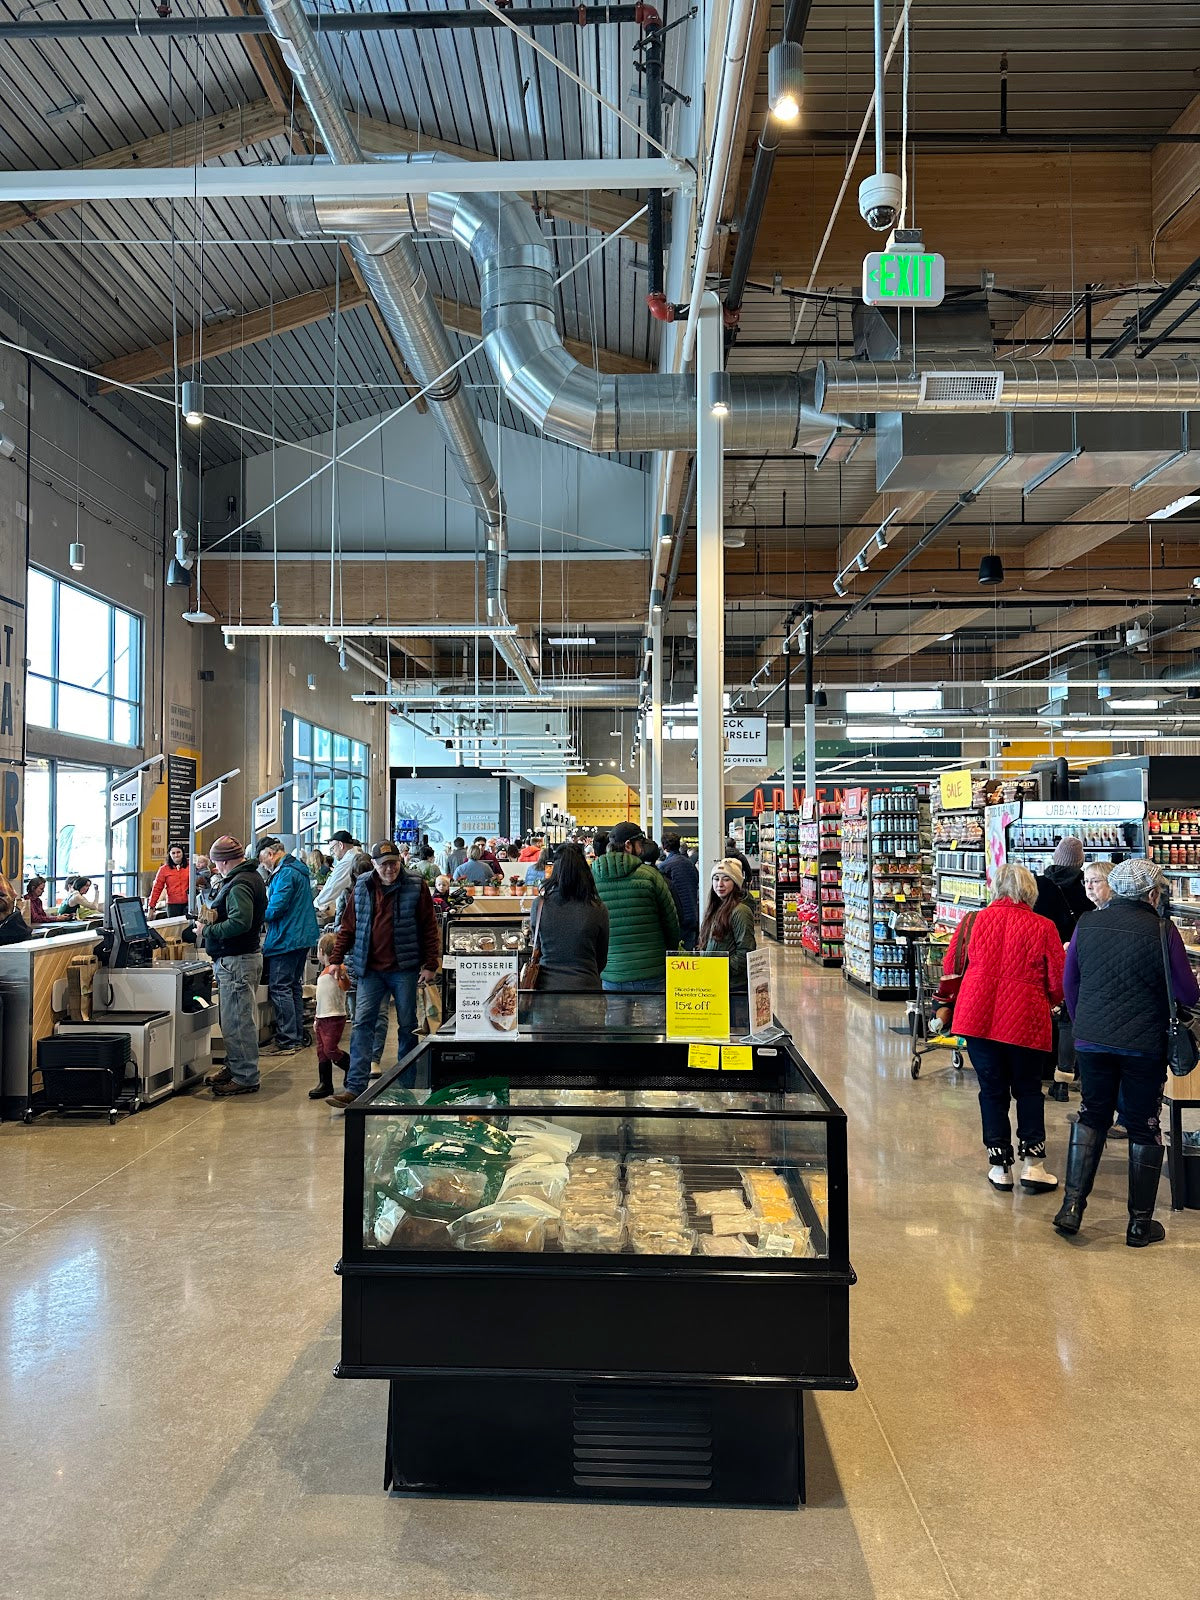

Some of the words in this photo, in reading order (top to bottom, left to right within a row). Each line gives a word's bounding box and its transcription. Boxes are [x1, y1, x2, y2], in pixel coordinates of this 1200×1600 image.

[880, 255, 936, 297] EXIT
[723, 719, 744, 728] ECK
[946, 780, 963, 799] SALE
[113, 793, 137, 802] SELF
[677, 800, 699, 810] YOU
[1046, 804, 1079, 816] URBAN
[1082, 804, 1121, 816] REMEDY
[671, 960, 700, 971] SALE
[675, 1001, 692, 1011] 15%
[694, 1001, 711, 1011] off
